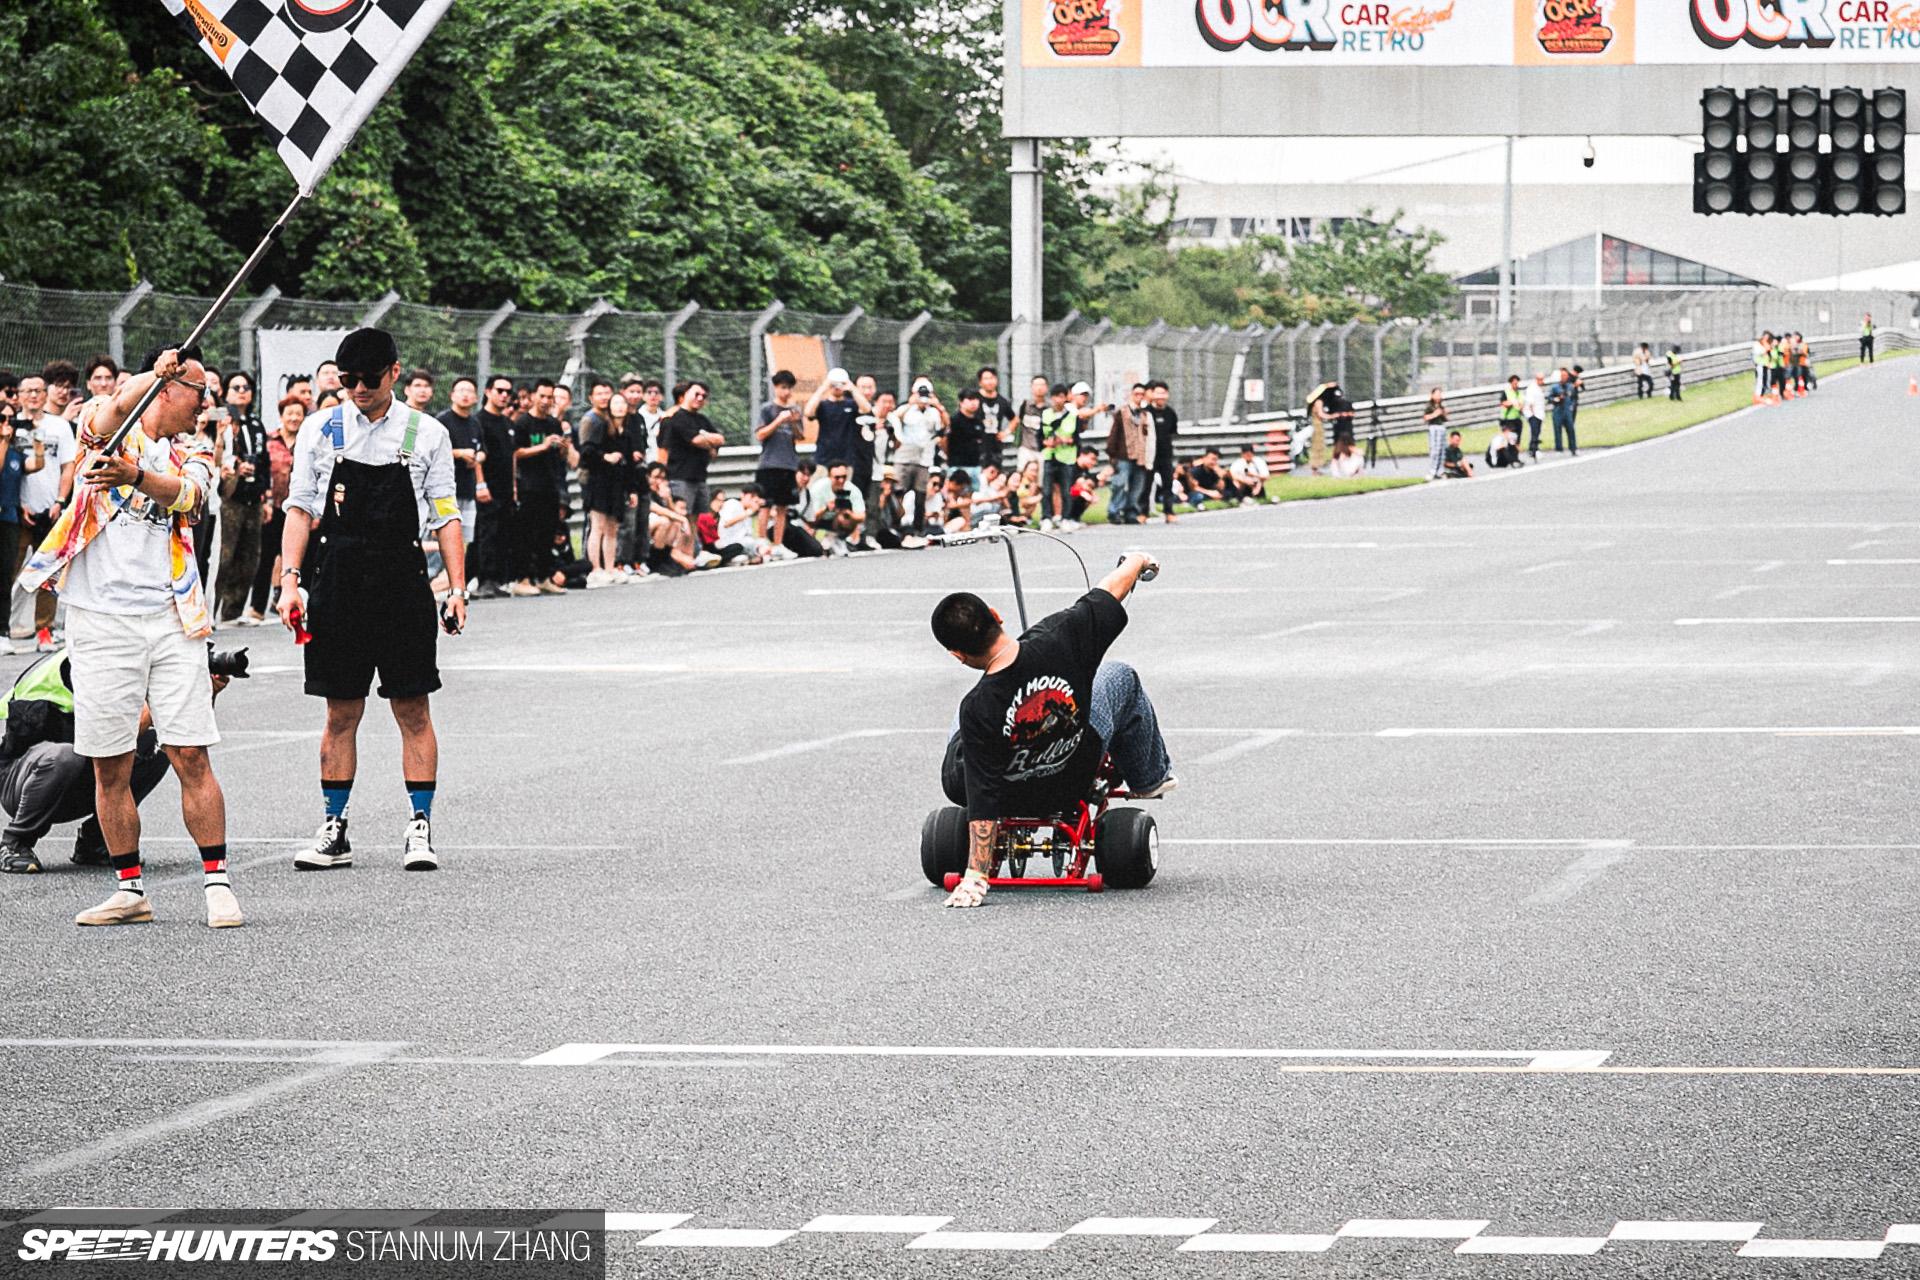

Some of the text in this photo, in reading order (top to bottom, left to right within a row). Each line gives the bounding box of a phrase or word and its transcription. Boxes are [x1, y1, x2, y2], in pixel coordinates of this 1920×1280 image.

[1053, 0, 1101, 25] OCR
[1341, 4, 1389, 26] CAR
[1544, 0, 1594, 22] OCR
[1839, 0, 1889, 23] CAR
[1195, 0, 1337, 52] OCR
[1689, 0, 1835, 49] OCR
[1342, 30, 1424, 52] RETRO
[1840, 27, 1920, 49] RETRO
[1026, 675, 1074, 698] MOUTH
